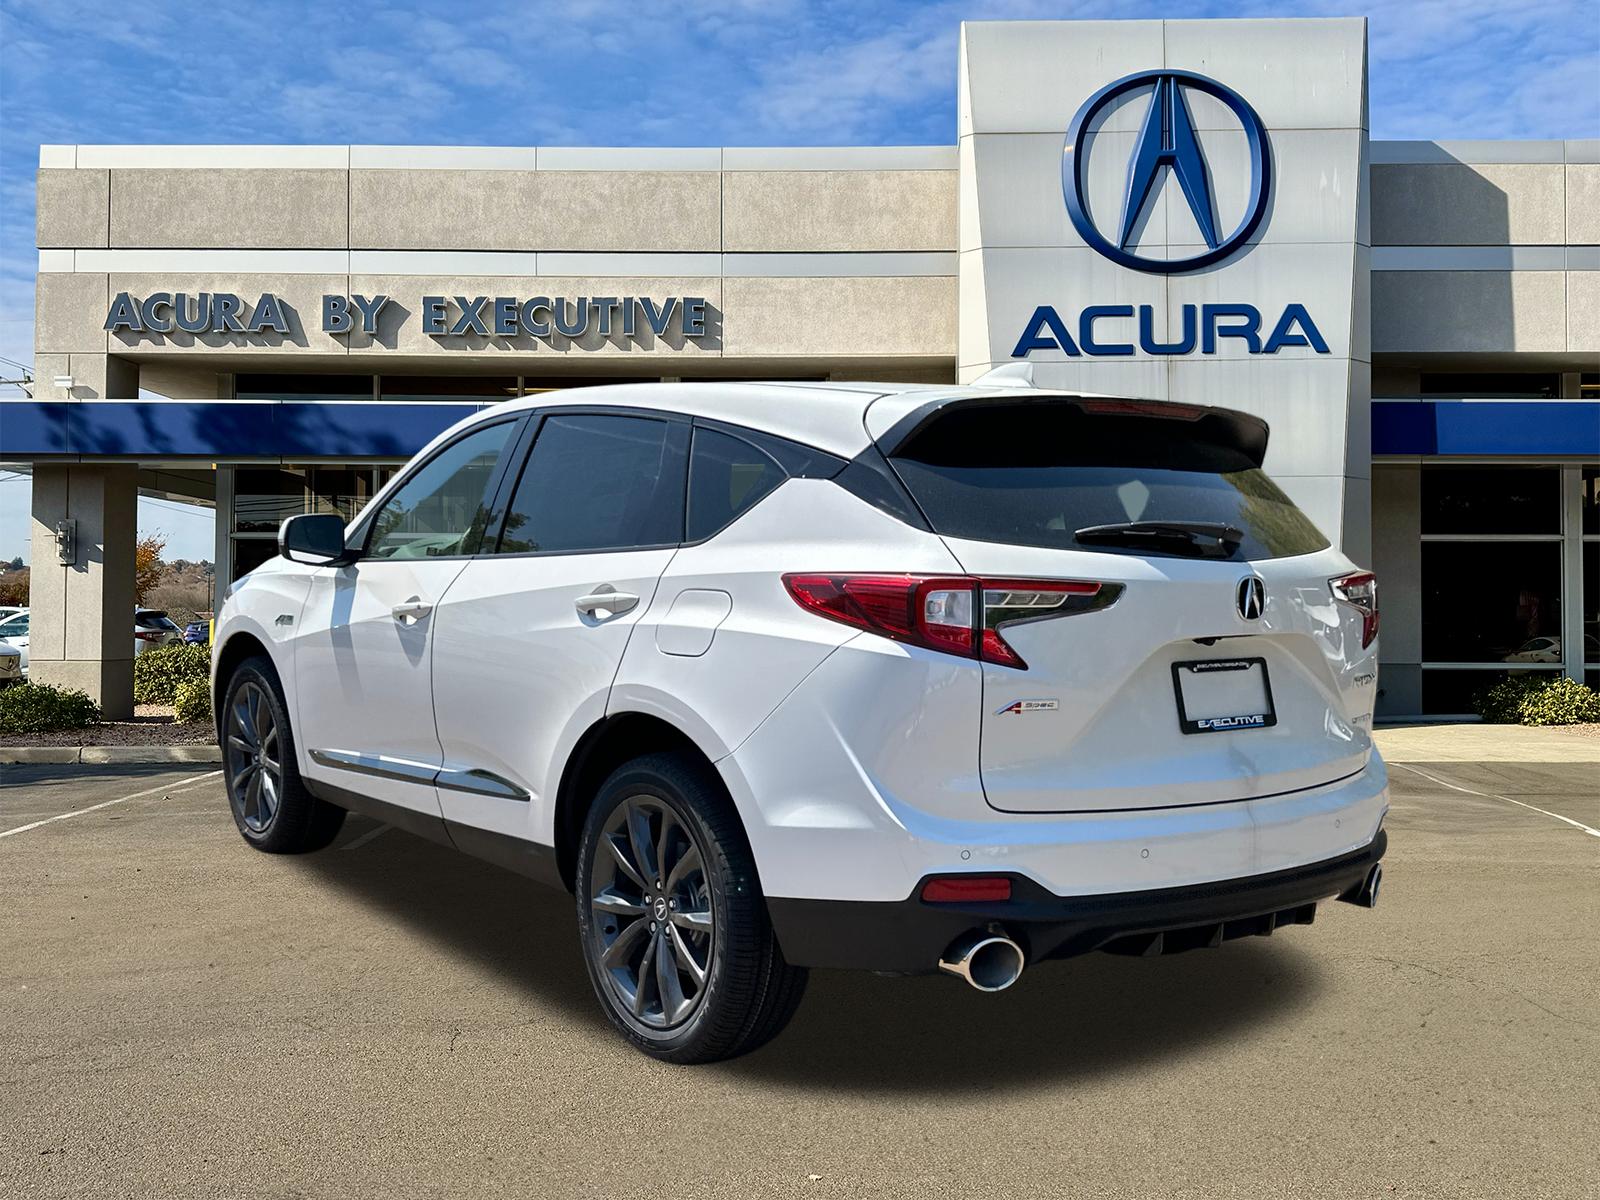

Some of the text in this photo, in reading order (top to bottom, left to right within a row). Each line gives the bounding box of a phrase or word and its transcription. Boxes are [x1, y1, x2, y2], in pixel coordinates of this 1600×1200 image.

[103, 291, 706, 336] ACURA BY EXECUTIVE
[1011, 303, 1332, 357] ACURA
[1198, 715, 1265, 729] EXECUTIVE
